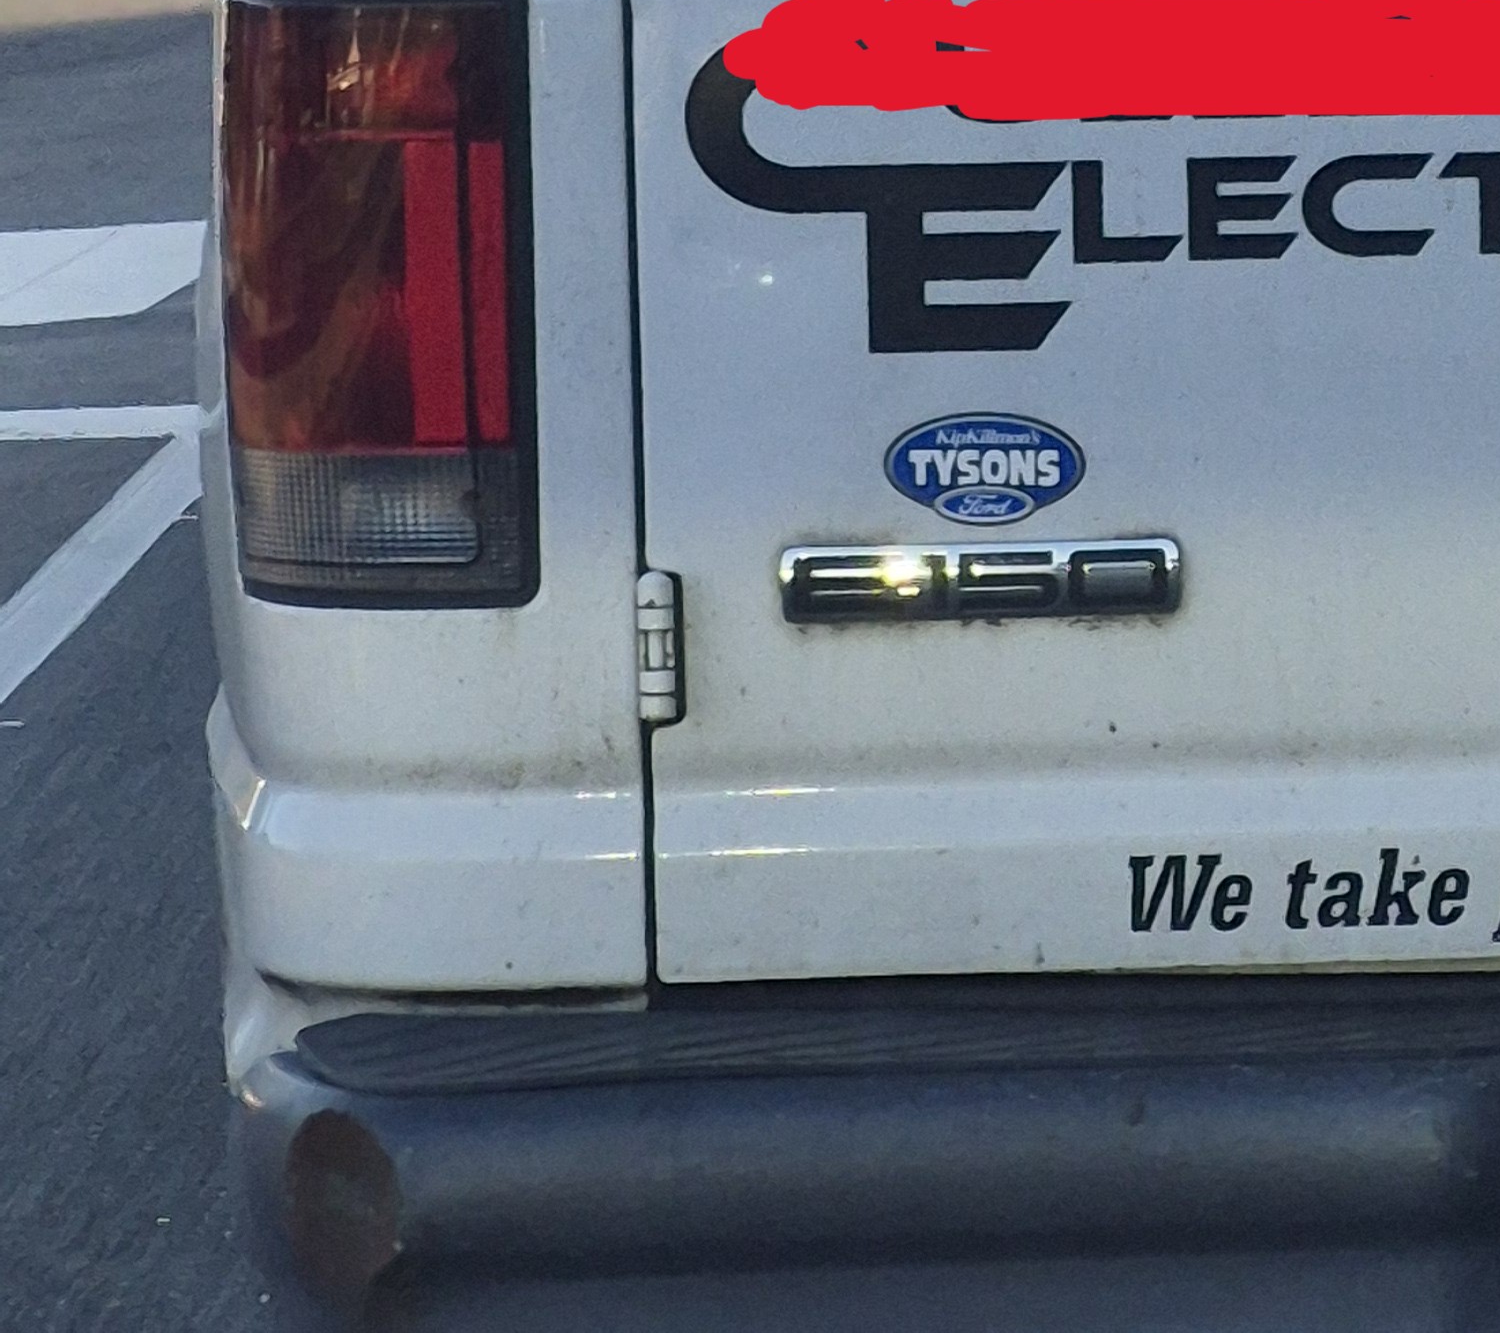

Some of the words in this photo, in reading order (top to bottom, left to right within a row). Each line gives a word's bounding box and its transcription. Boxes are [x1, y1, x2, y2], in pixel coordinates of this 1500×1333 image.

[908, 449, 1061, 487] TYSONS
[958, 494, 1013, 515] Ford
[1129, 853, 1253, 933] We
[1285, 847, 1470, 930] take
